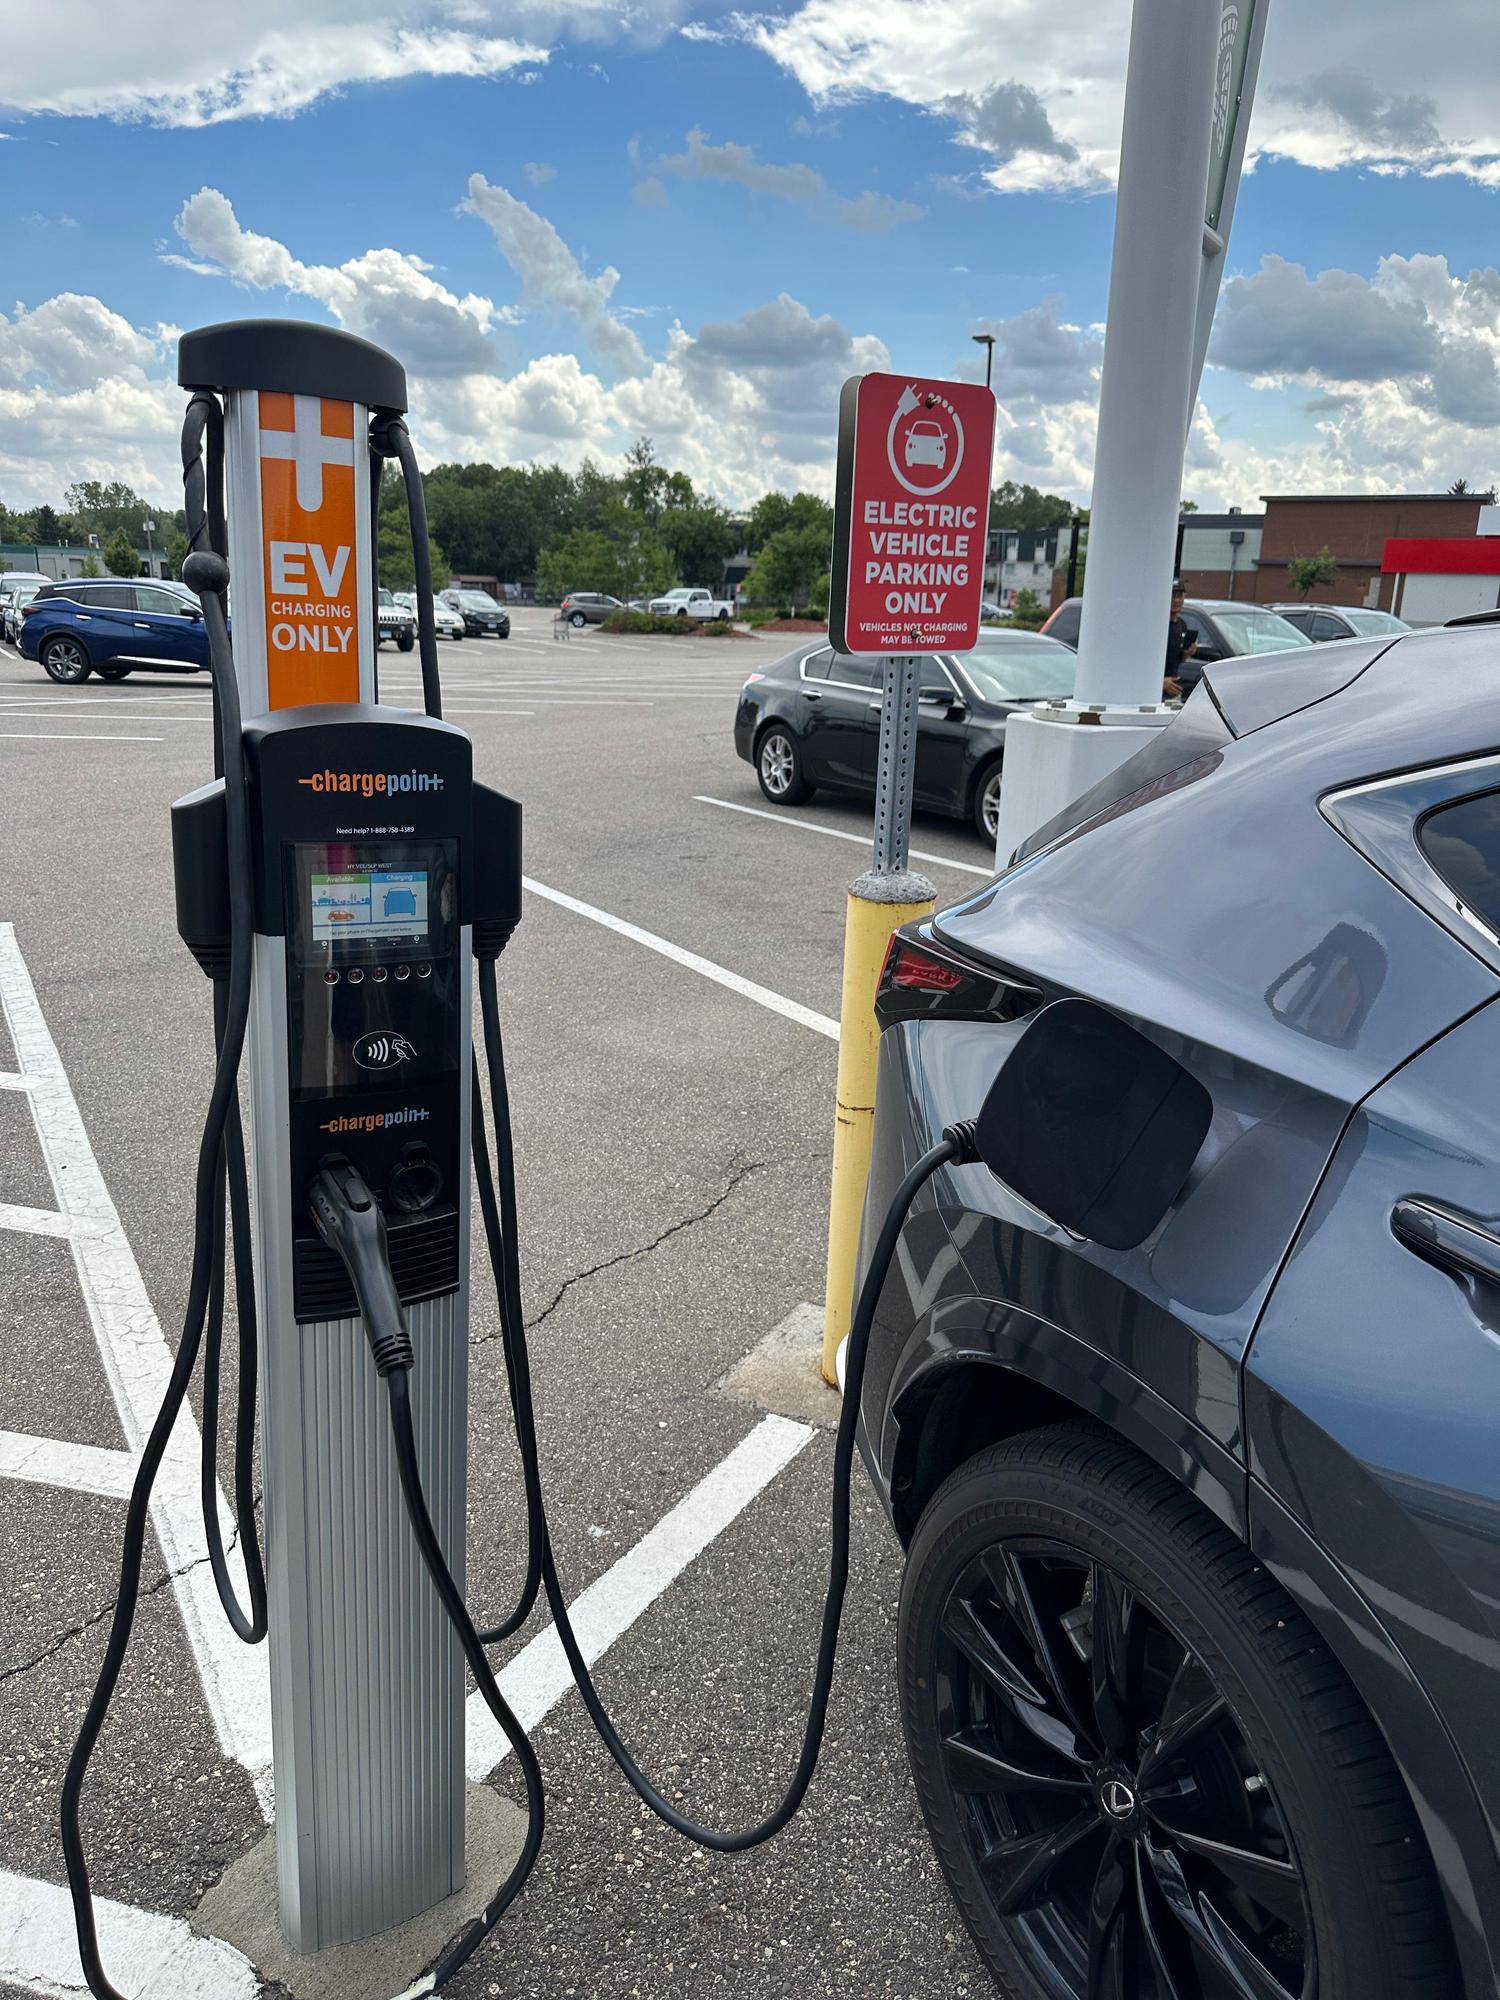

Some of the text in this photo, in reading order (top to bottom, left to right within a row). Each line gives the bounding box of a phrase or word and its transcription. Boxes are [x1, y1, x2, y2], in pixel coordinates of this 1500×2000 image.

[864, 500, 977, 529] ELECTRIC
[869, 531, 969, 557] VEHICLE
[270, 541, 351, 597] EV
[865, 561, 969, 586] PARKING
[271, 601, 351, 618] CHARGING
[885, 591, 947, 614] ONLY
[271, 623, 353, 653] ONLY
[859, 623, 968, 632] VEHICLES NOT CHARGING
[880, 635, 900, 644] MAY
[901, 635, 913, 644] BE
[298, 769, 445, 797] chargepoint
[353, 827, 369, 835] help?
[370, 826, 415, 834] 1-888-758-4389
[326, 875, 354, 883] Available
[386, 874, 413, 882] Charging
[319, 1107, 430, 1133] chargepoint
